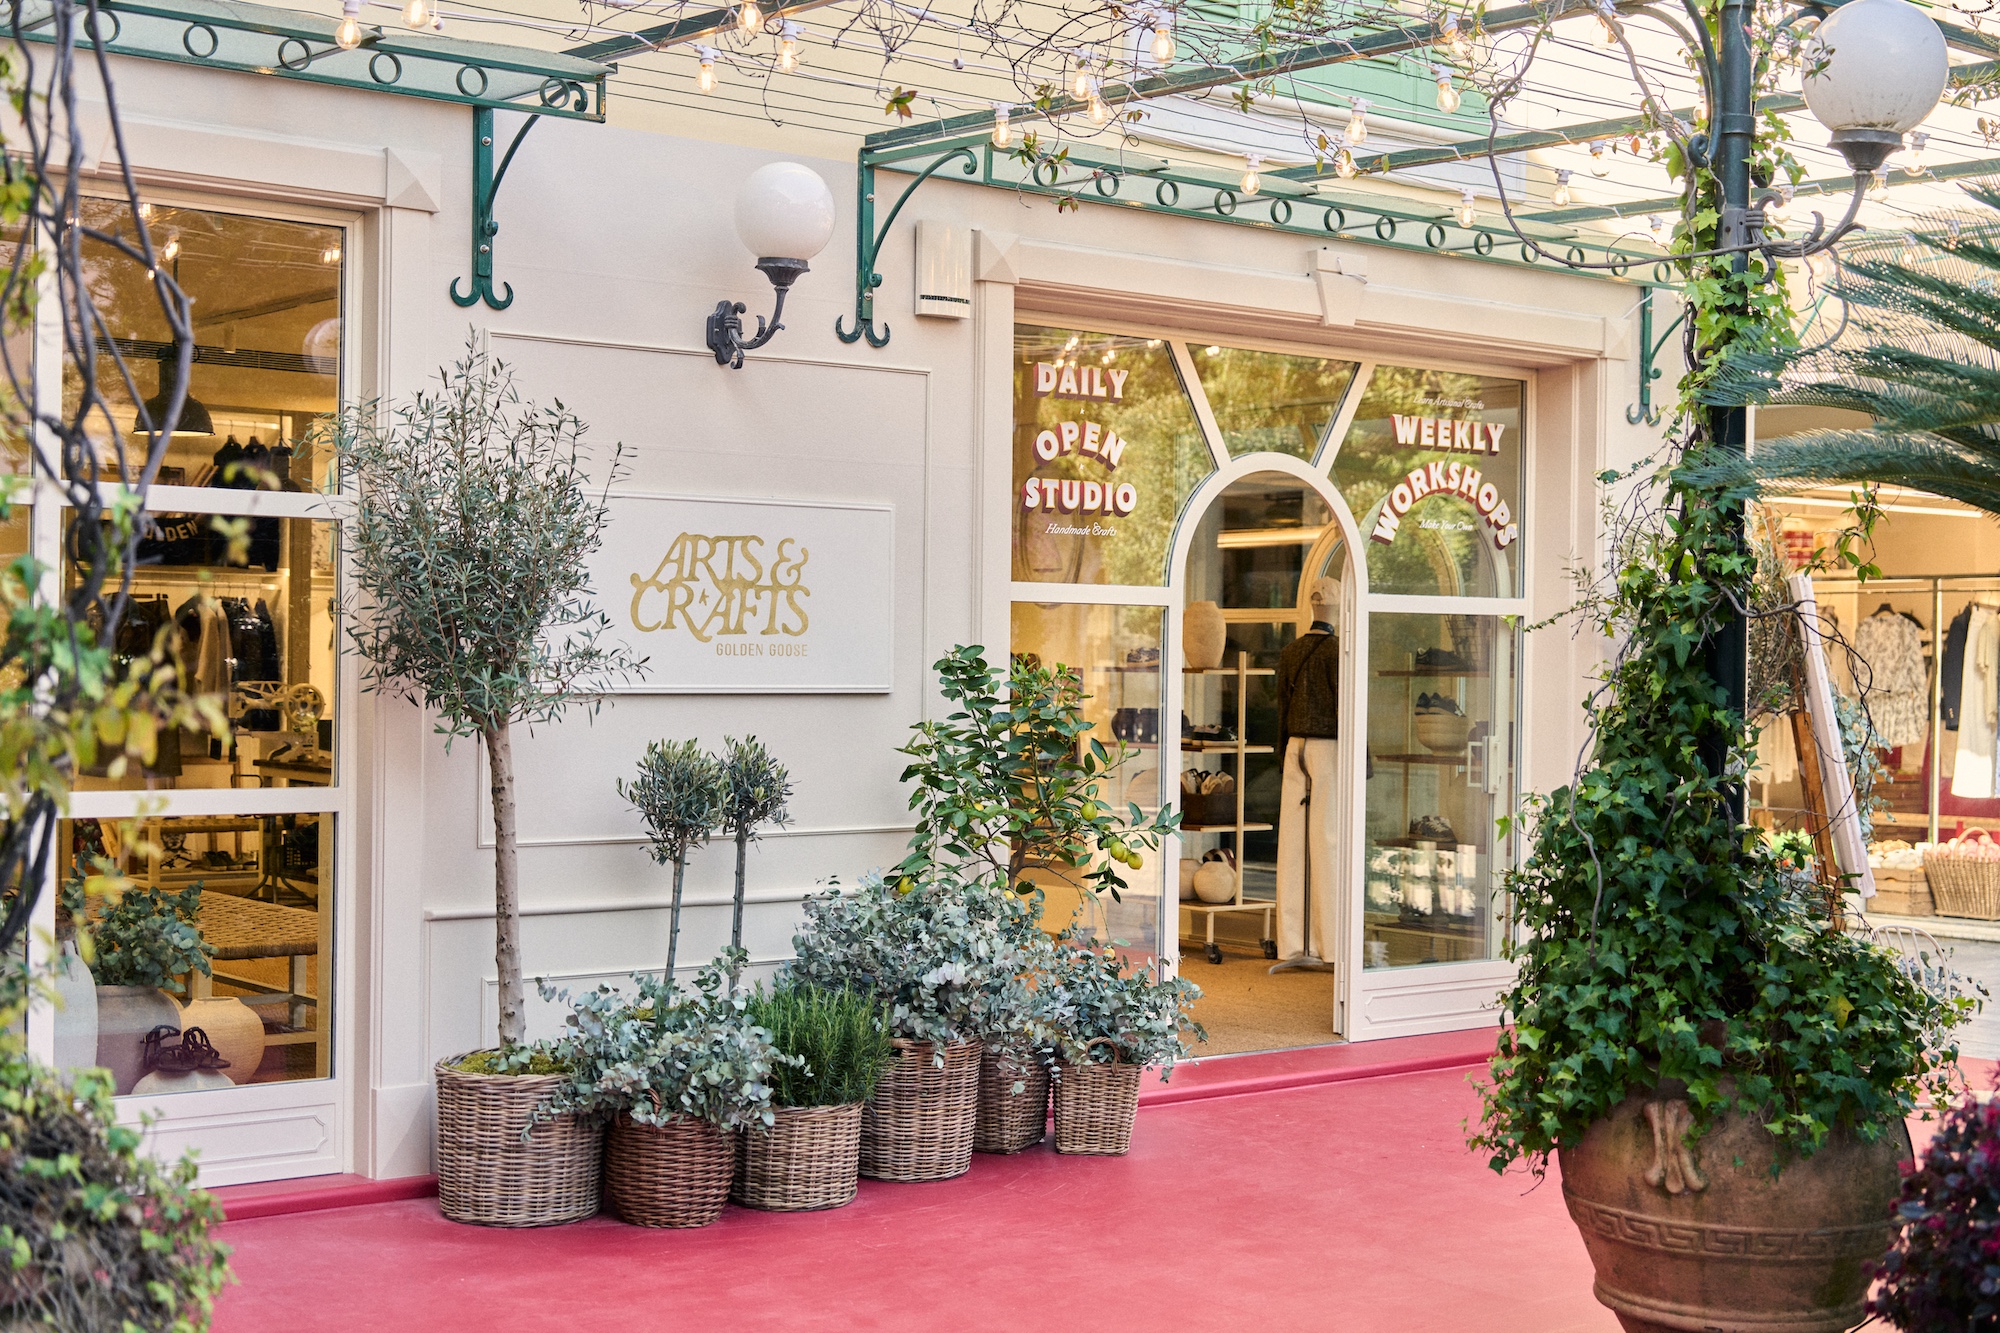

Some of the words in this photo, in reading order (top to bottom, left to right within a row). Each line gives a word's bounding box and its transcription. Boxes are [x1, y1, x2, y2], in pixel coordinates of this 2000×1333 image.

[1033, 361, 1129, 404] DAILY
[1032, 420, 1127, 473] OPEN
[1390, 413, 1505, 456] WEEKLY
[1021, 477, 1137, 518] STUDIO
[1371, 460, 1518, 550] WORKSHOPS
[1045, 523, 1091, 536] Handmade
[1092, 521, 1118, 537] Crafts
[1419, 519, 1440, 529] Make
[1440, 519, 1457, 530] Your
[1457, 521, 1474, 531] Own
[630, 579, 811, 643] CRAFTS
[716, 643, 764, 656] GOLDEN
[769, 643, 808, 657] GOOSE
